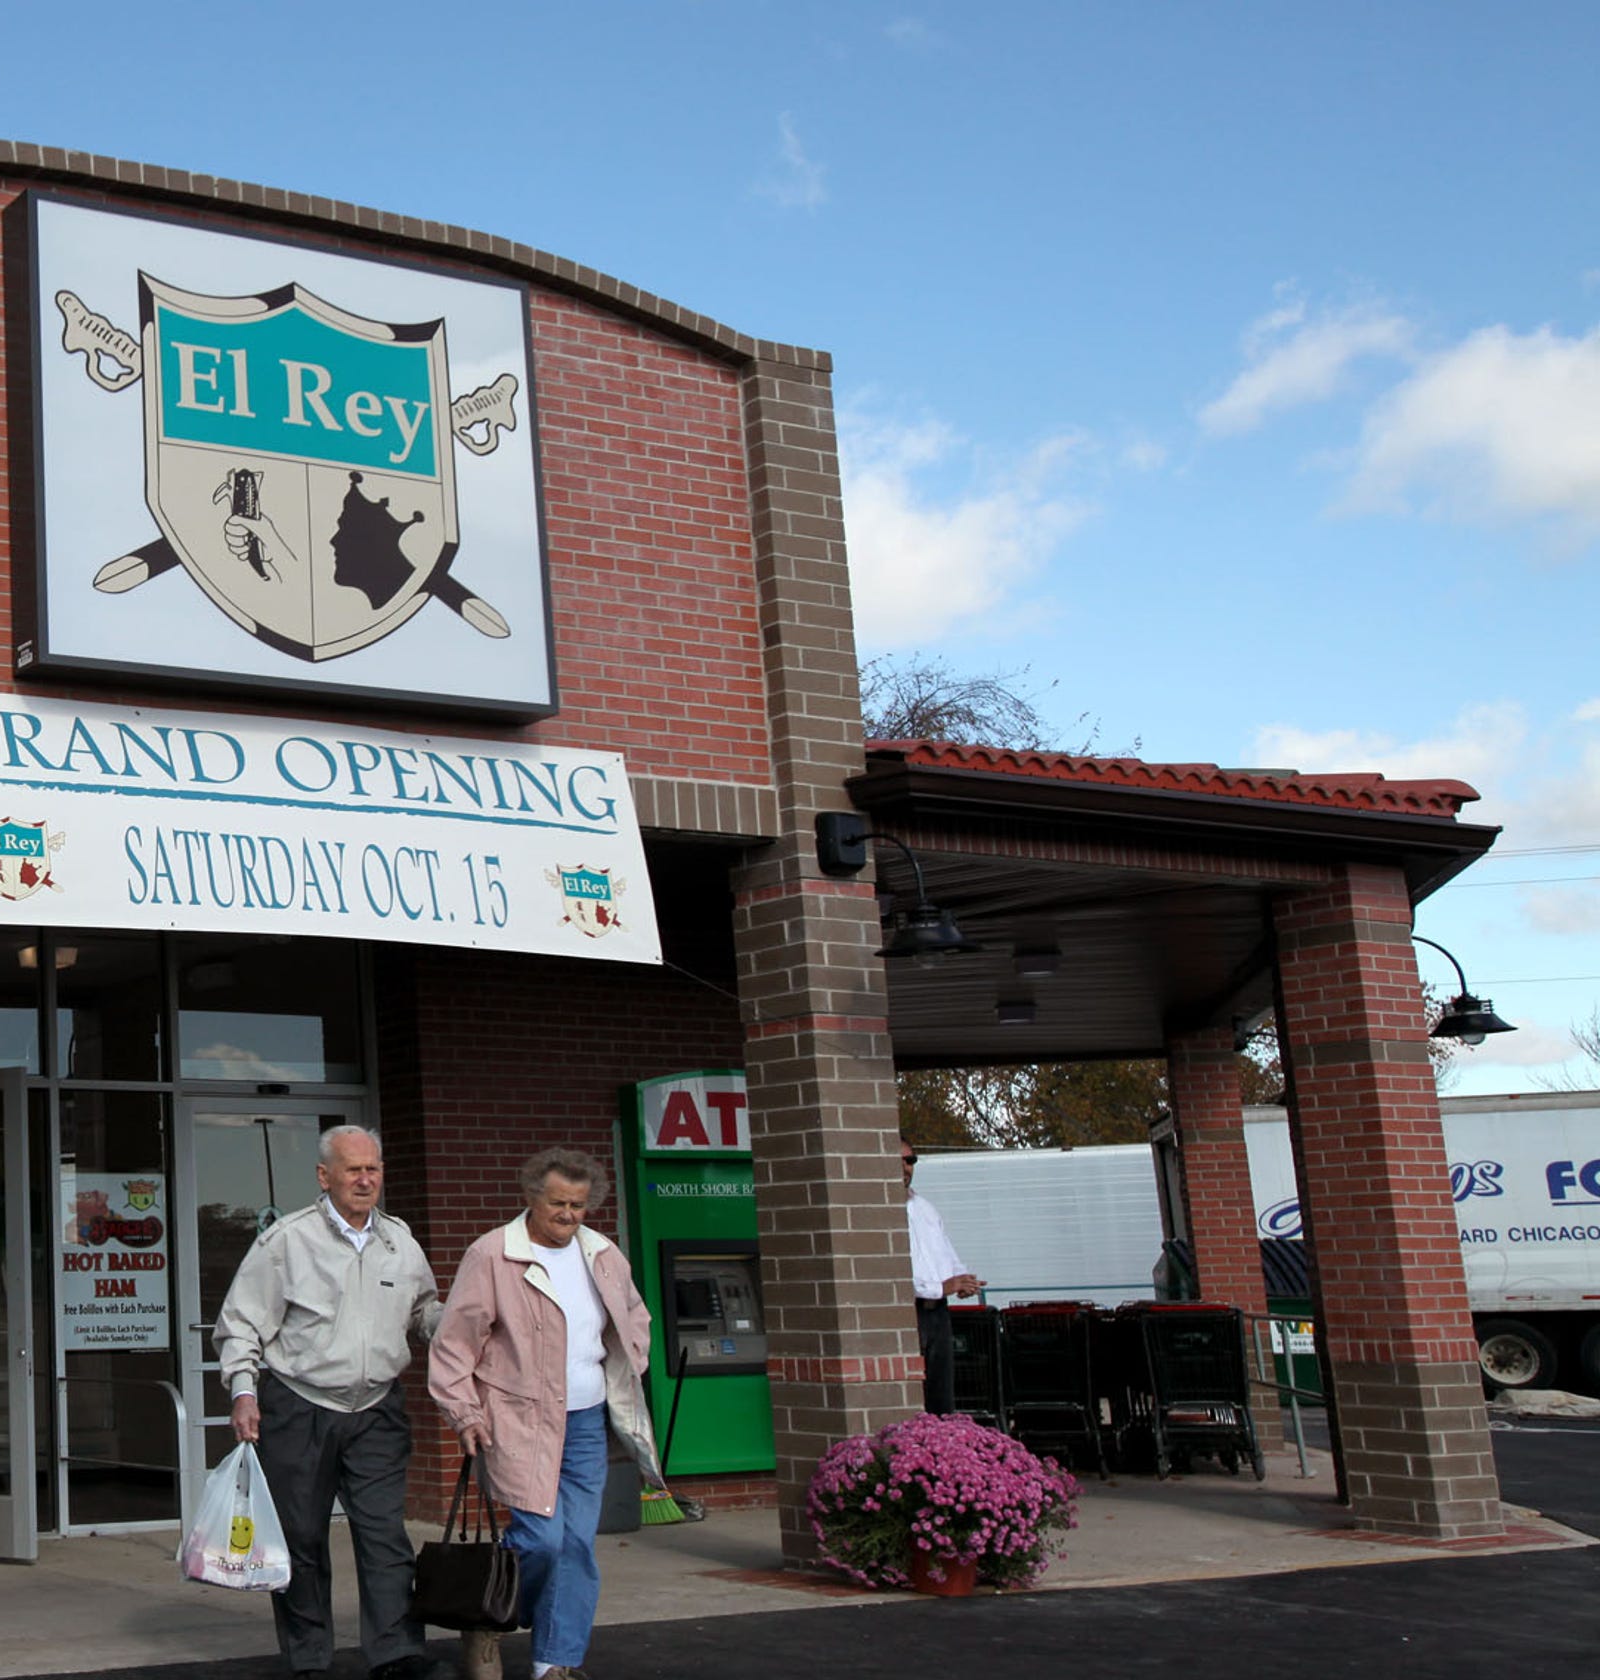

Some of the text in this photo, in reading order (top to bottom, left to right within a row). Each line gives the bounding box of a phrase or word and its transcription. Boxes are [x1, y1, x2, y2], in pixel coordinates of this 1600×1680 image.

[171, 341, 430, 463] El Rey
[275, 736, 618, 823] OPENING
[4, 833, 40, 855] Rey
[124, 825, 509, 928] SATURDAY OCT. 15
[564, 876, 608, 899] El Rey
[656, 1091, 747, 1146] AT
[657, 1183, 698, 1195] NORTH
[701, 1183, 740, 1195] SHORE
[1460, 1226, 1600, 1243] ARD CHICAGO
[62, 1252, 166, 1272] HOT BAKED
[94, 1278, 138, 1298] HAM
[120, 1302, 136, 1314] Each
[137, 1302, 166, 1314] Purchase
